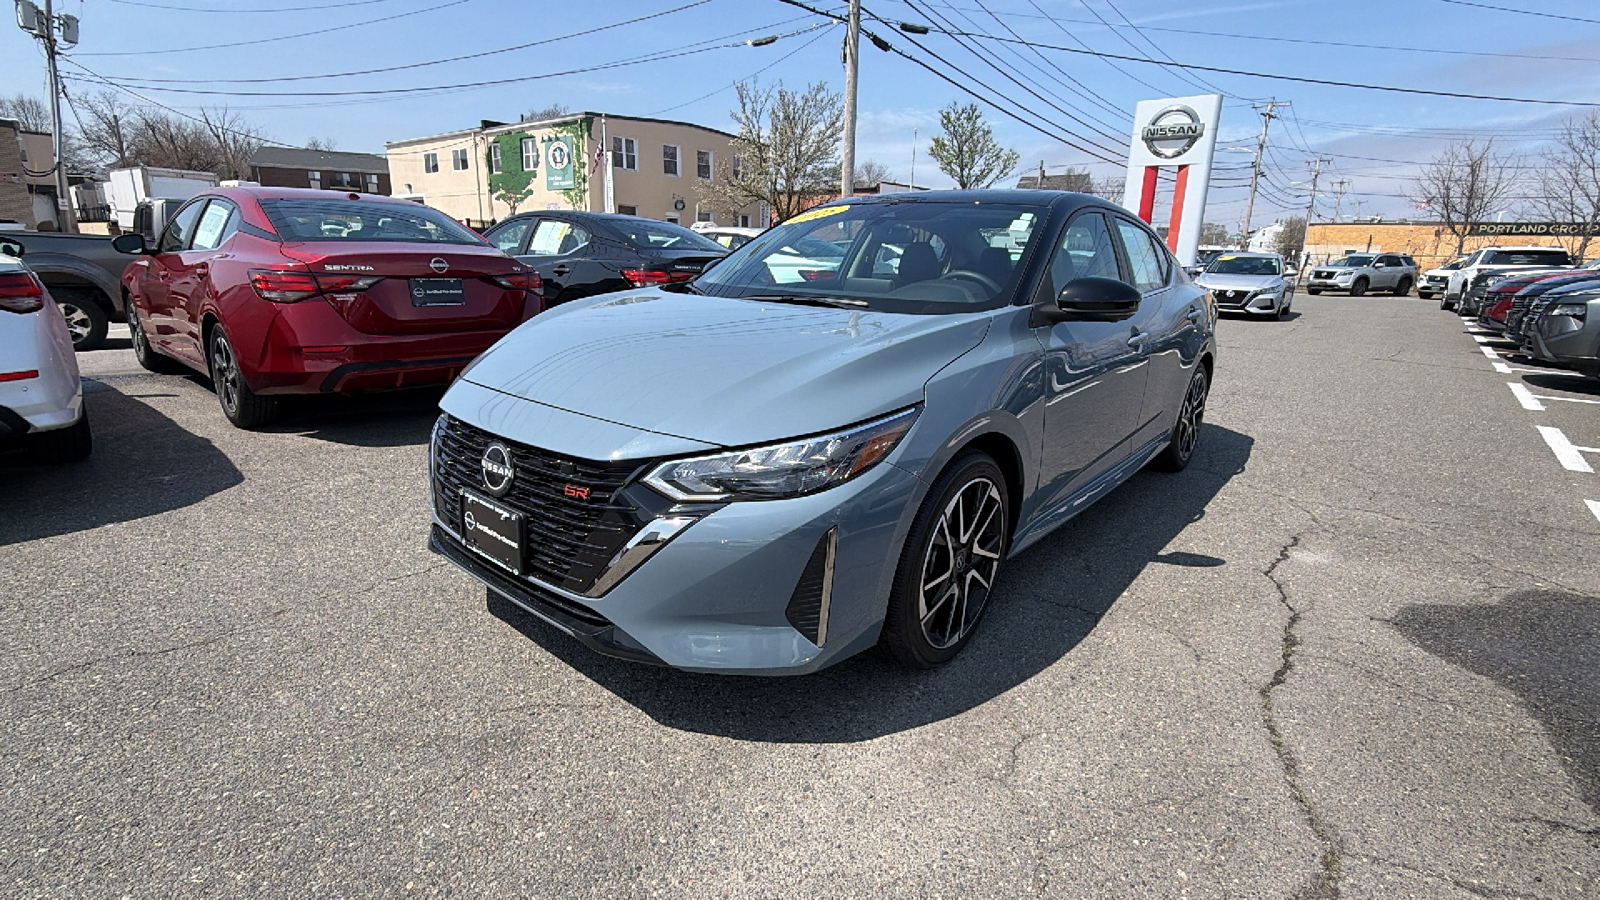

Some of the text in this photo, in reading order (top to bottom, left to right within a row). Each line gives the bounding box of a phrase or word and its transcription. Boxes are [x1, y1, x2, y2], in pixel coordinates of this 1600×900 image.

[1146, 125, 1198, 137] NISSAN
[1479, 224, 1548, 234] PORTLAND
[481, 458, 513, 478] NISSAN
[564, 484, 589, 500] SR
